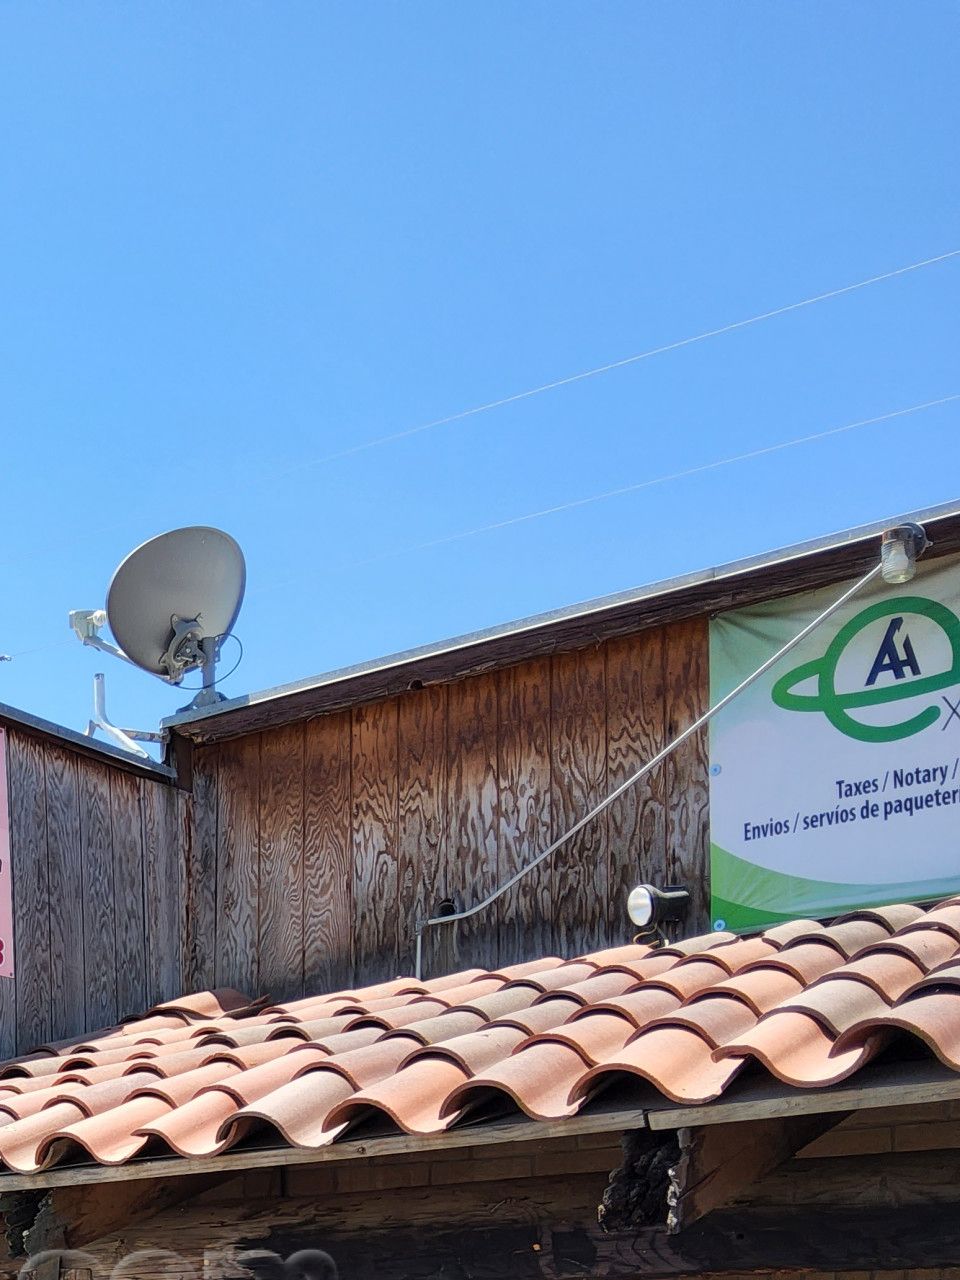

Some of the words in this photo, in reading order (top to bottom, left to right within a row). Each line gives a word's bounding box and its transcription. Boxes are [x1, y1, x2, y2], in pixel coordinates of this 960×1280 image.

[835, 778, 879, 800] Taxes
[893, 765, 948, 789] Notary
[744, 817, 790, 841] Envios
[803, 804, 857, 830] servíos
[860, 799, 880, 820] de
[884, 787, 960, 821] paqueter
